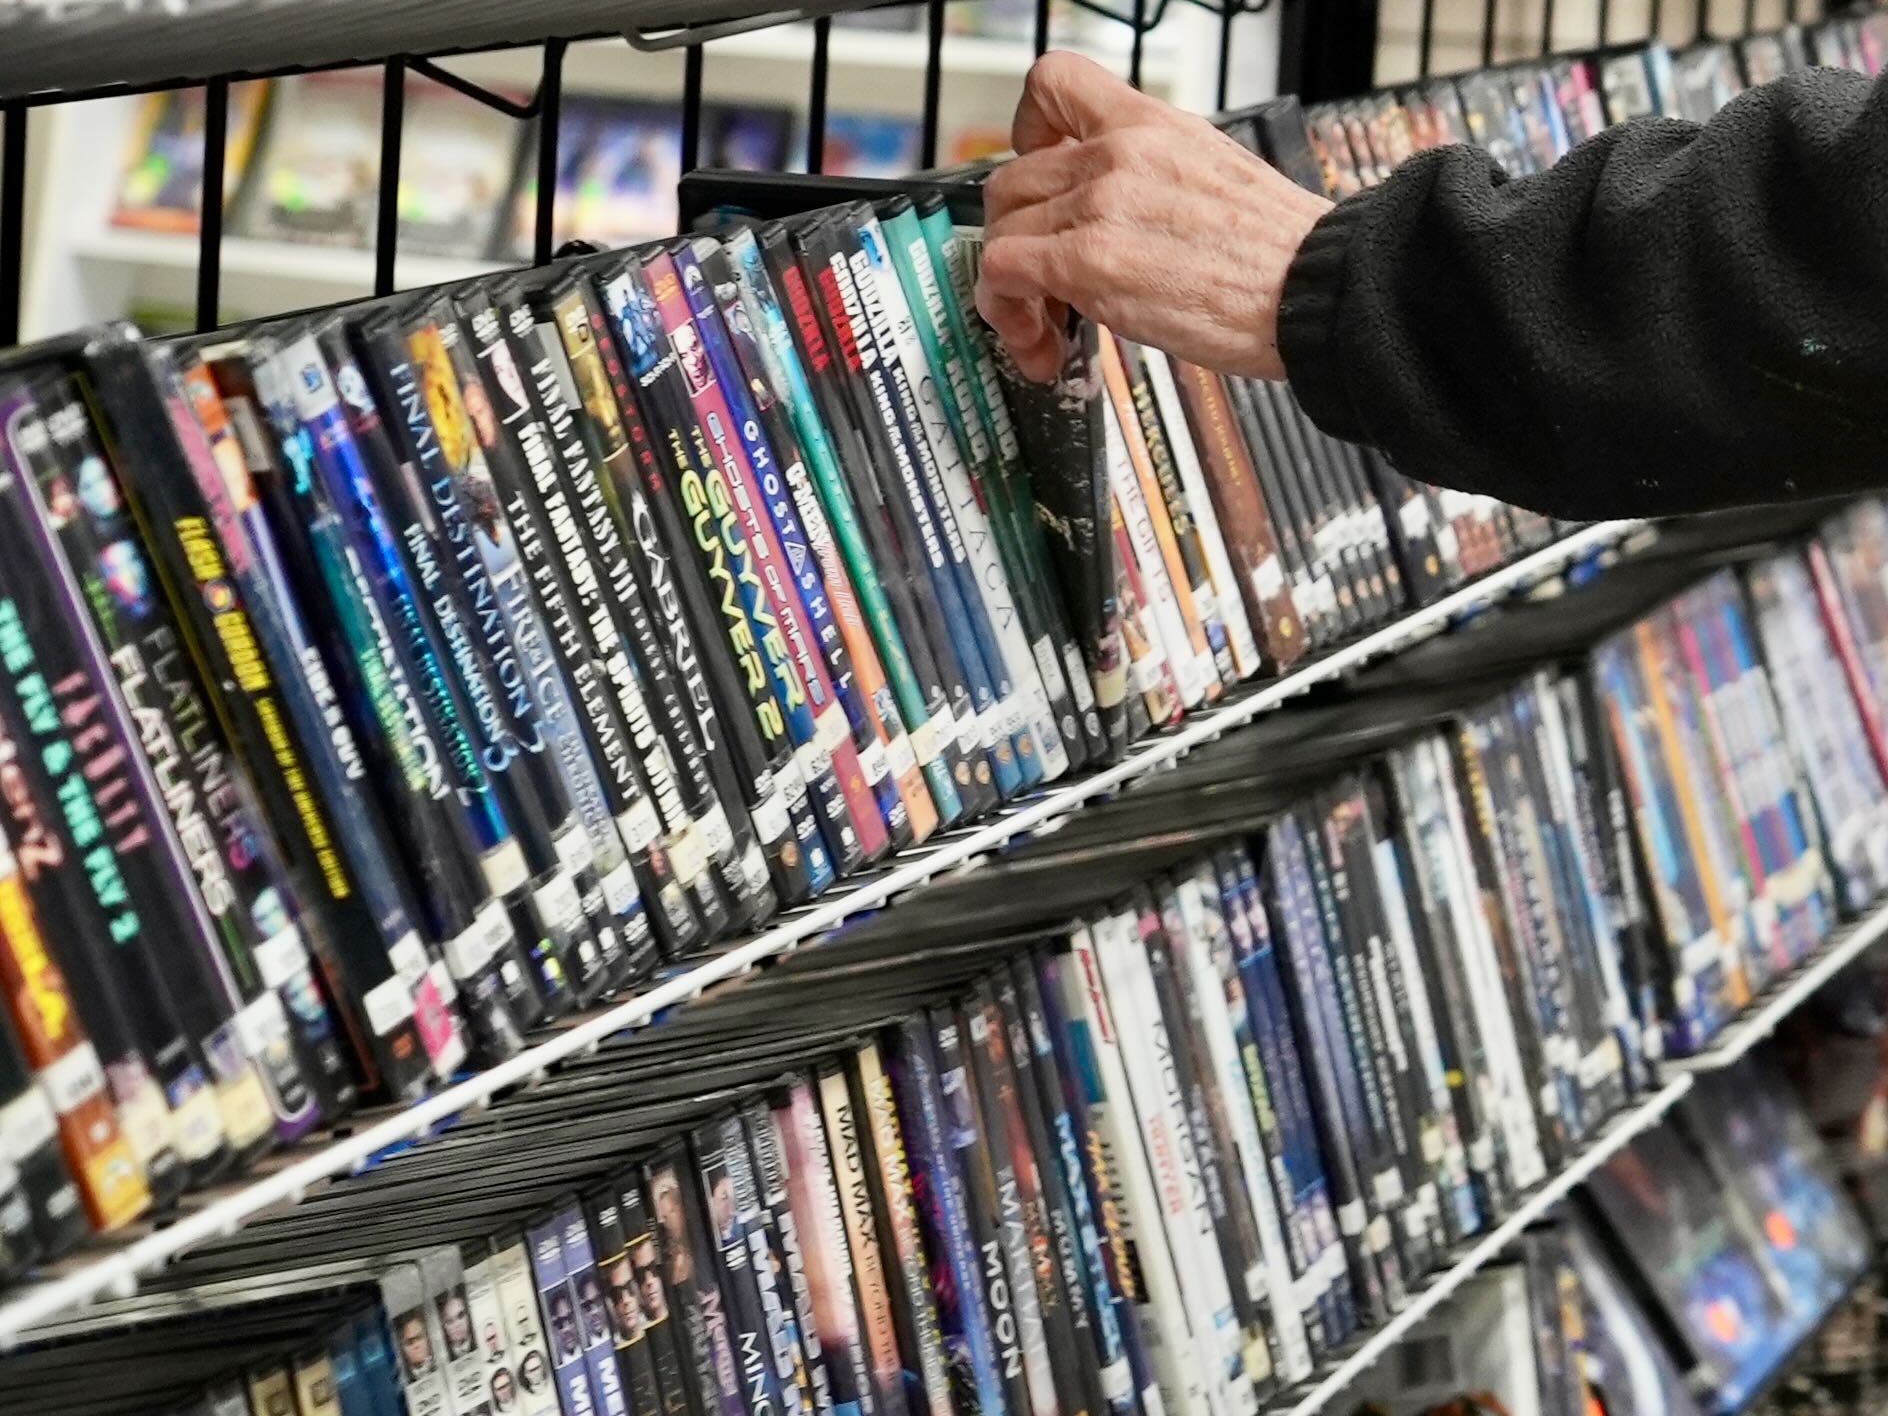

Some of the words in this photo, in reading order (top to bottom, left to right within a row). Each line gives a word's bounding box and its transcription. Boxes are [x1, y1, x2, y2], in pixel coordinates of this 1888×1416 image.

[531, 358, 573, 441] FINAL
[591, 312, 664, 491] GEOSTORM
[783, 266, 831, 373] GODZILLA
[829, 251, 879, 370] GODZILLA
[869, 370, 897, 427] KING
[894, 442, 945, 568] MONSTERS
[849, 249, 900, 368] GODZILLA
[892, 367, 918, 422] KING
[915, 439, 967, 564] MONSTERS
[909, 237, 951, 346] GODZILLA
[947, 358, 989, 463] KONG
[977, 357, 1019, 461] KONG
[390, 363, 440, 470] FINAL
[431, 476, 532, 718] DESTINATION
[668, 428, 688, 469] THE
[680, 470, 767, 698] GUYVER
[756, 696, 784, 741] 2
[690, 424, 713, 468] THE
[705, 470, 806, 713] GUYVER
[707, 412, 769, 560] GHOSTS
[764, 565, 787, 603] OF
[780, 607, 826, 706] MARS
[743, 420, 797, 535] GHOST
[801, 572, 852, 690] SHELL
[918, 376, 1013, 630] GATTACA
[1133, 382, 1195, 535] HERCULES
[173, 516, 225, 582] FLASH
[213, 609, 271, 692] GORDON
[403, 522, 442, 591] FINAL
[434, 593, 506, 744] DESTINATION
[483, 743, 520, 772] 3
[507, 490, 543, 561] THE
[534, 564, 582, 659] FIFTH
[573, 663, 641, 799] ELEMENT
[517, 421, 558, 494] FINAL
[588, 603, 620, 654] THE
[605, 651, 657, 749] SPIRITS
[631, 490, 716, 752] GABRIEL
[16, 672, 62, 733] FLY
[57, 772, 104, 848] THE
[84, 846, 129, 908] FLY
[109, 910, 140, 945] 2
[52, 670, 150, 855] FACULTY
[109, 642, 237, 917] FLATLINERS
[142, 625, 259, 870] FLATLINERS
[834, 1104, 861, 1174] MAD
[849, 1179, 878, 1248] MAX
[884, 1152, 911, 1222] MAX
[979, 1239, 1024, 1378] MOON
